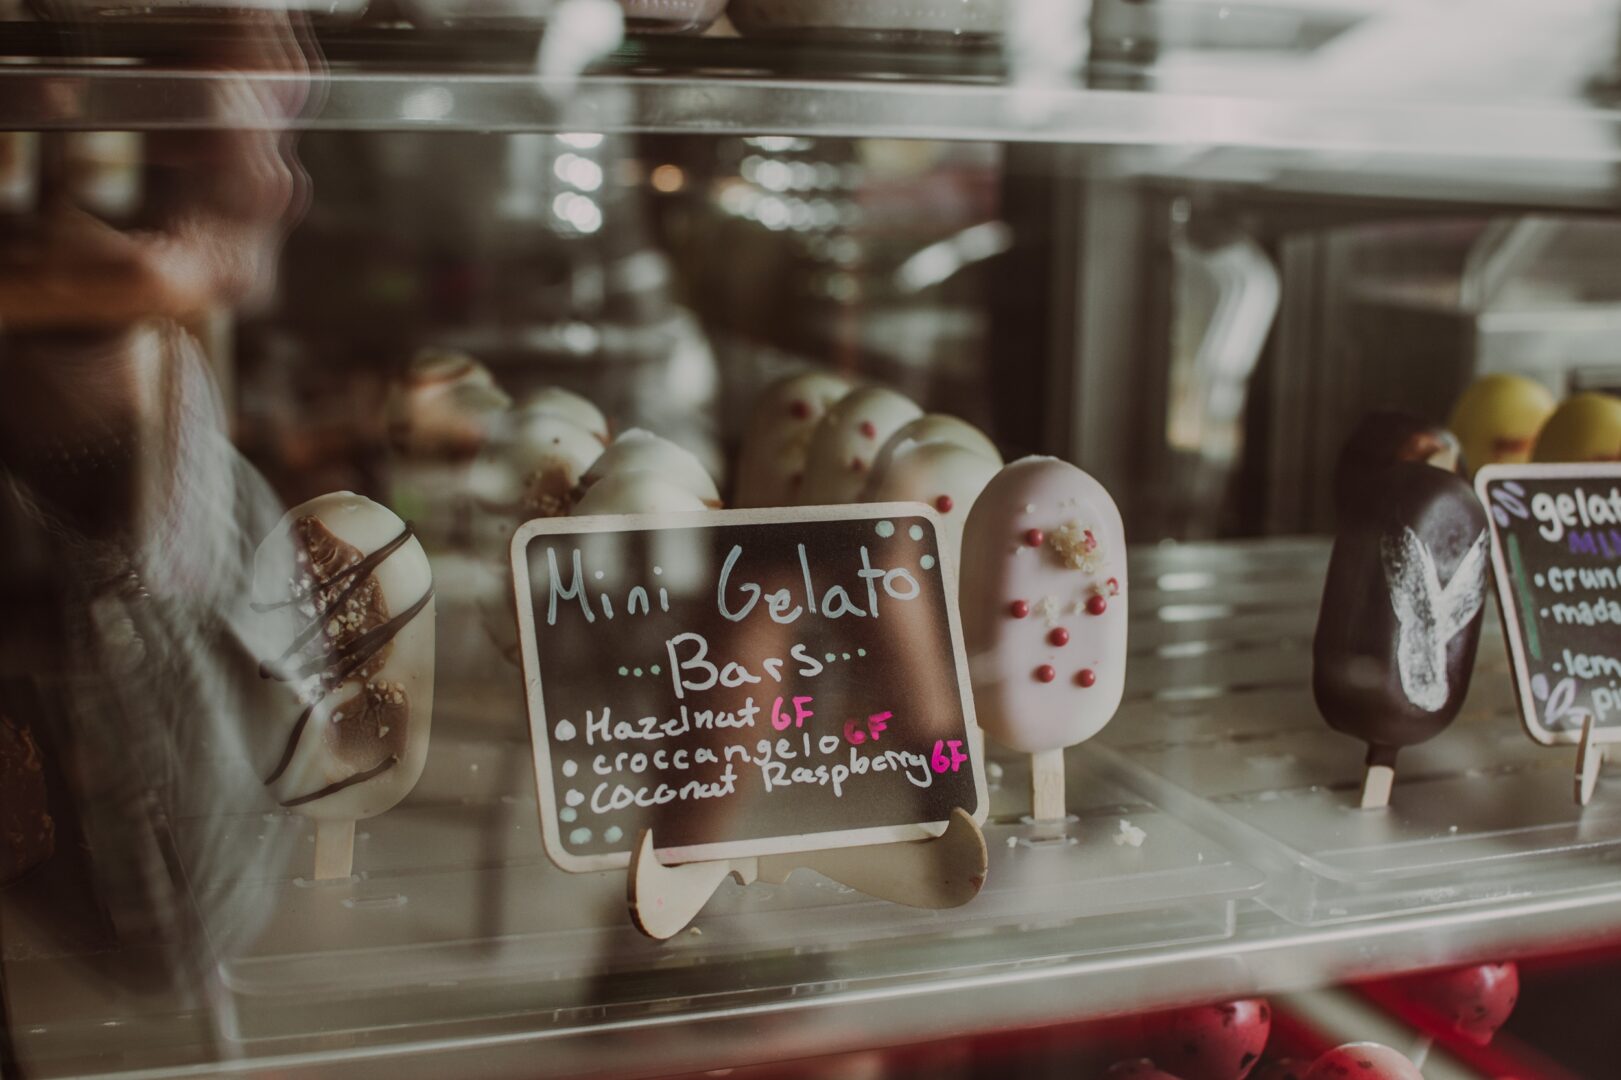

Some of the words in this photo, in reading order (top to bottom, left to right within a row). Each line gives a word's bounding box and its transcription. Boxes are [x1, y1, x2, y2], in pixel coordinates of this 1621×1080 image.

[547, 547, 669, 625] Mini
[718, 544, 920, 624] Gelato
[586, 697, 760, 745] Hazelnut
[761, 747, 932, 798] Raspberry
